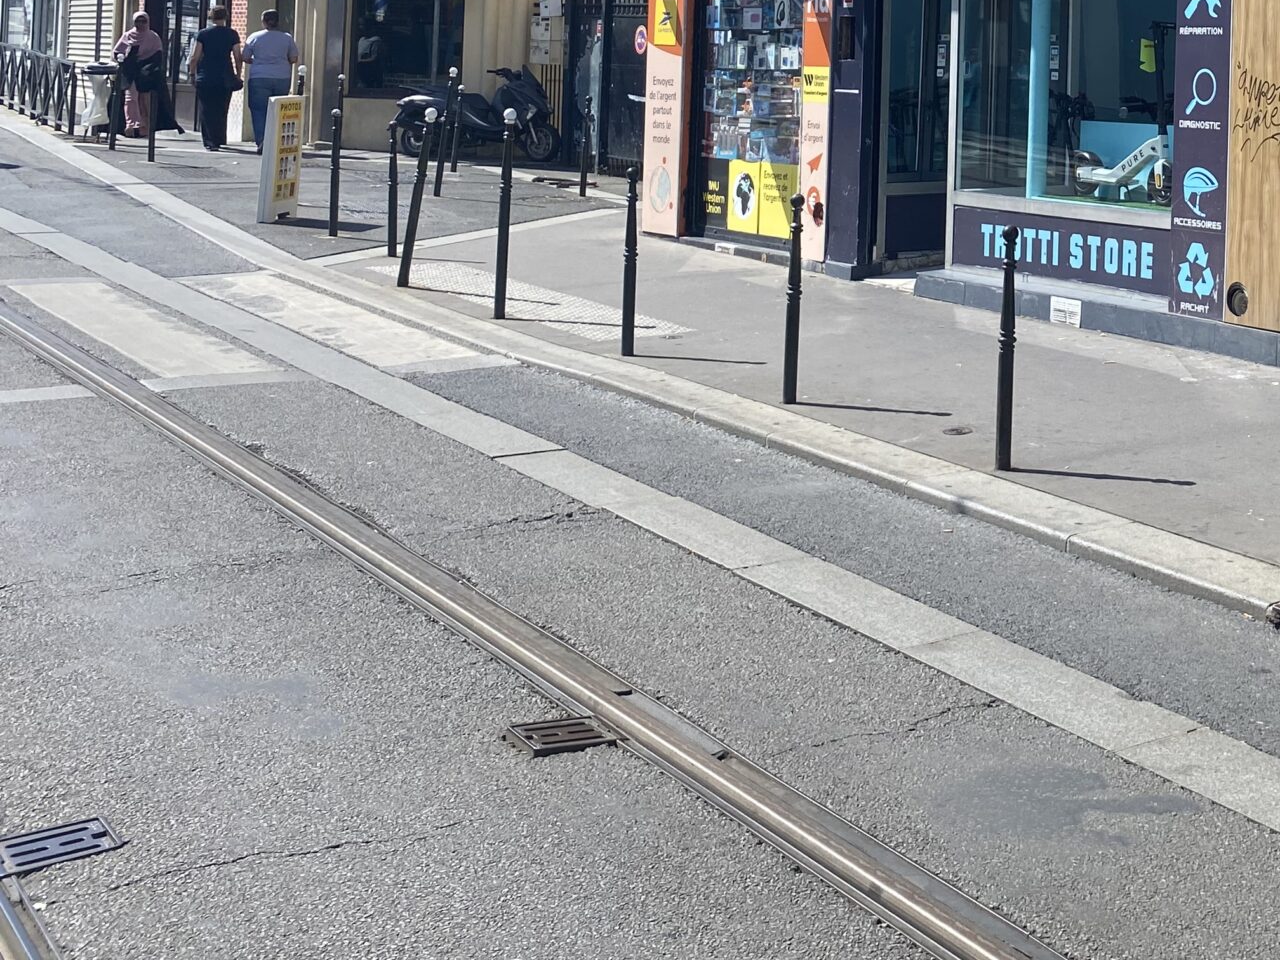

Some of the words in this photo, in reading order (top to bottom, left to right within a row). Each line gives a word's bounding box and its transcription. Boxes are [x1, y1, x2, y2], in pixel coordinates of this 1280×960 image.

[1179, 26, 1223, 36] RÉPARATION
[652, 76, 674, 87] Envoyez
[652, 107, 672, 116] partout
[652, 120, 665, 129] dans
[666, 121, 672, 129] le
[807, 120, 820, 130] Envoi
[1178, 119, 1221, 130] DIAGNOSTIC
[652, 135, 671, 144] monde
[1121, 148, 1146, 173] PURE
[702, 191, 725, 204] Western
[706, 202, 722, 215] Union
[1174, 217, 1222, 230] ACCESSOIRES
[1069, 233, 1154, 280] STORE
[1180, 302, 1209, 314] RACHAT
